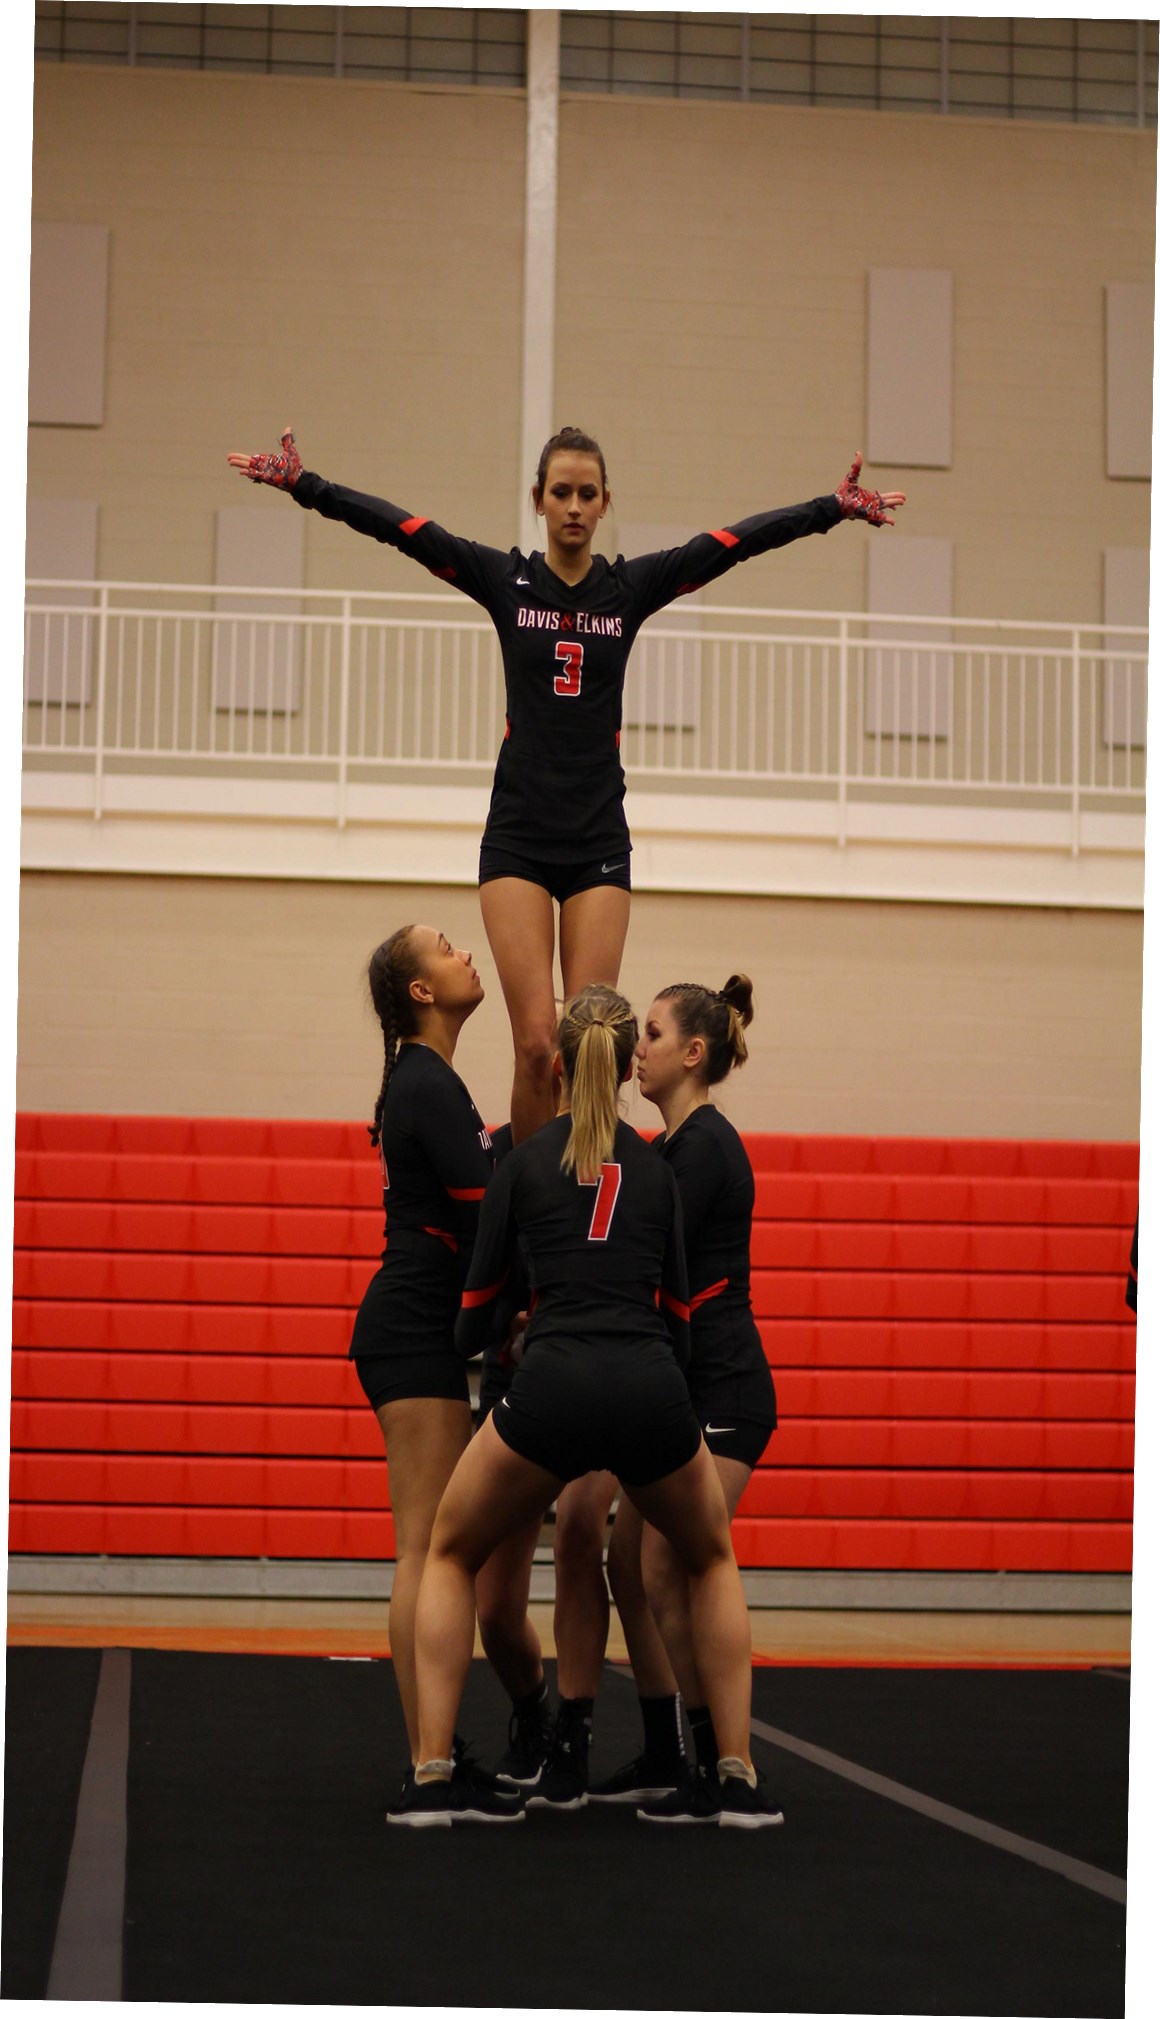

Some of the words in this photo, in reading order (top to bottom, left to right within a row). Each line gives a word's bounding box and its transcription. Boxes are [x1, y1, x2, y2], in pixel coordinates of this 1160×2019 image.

[517, 607, 560, 630] DAVIS
[576, 612, 622, 638] ELKINS
[553, 640, 584, 697] 3
[576, 1162, 622, 1241] 7
